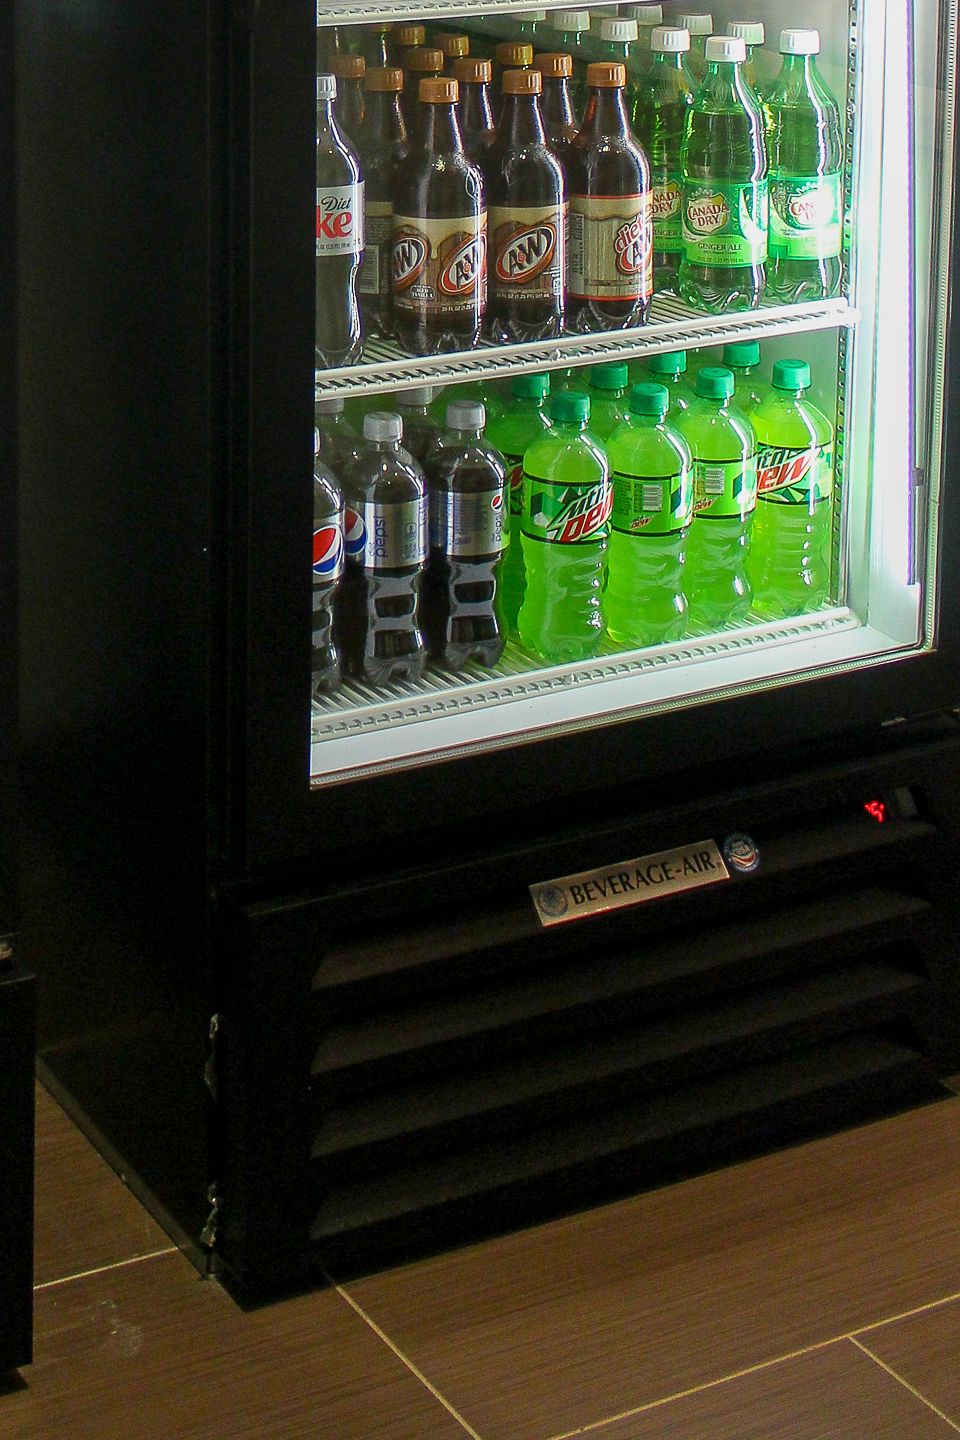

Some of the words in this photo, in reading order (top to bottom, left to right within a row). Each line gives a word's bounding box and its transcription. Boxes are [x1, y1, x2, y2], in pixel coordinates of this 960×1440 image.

[321, 195, 352, 211] Diet
[653, 191, 680, 205] NADA
[653, 201, 674, 214] DRY
[689, 203, 730, 221] CANADA
[316, 205, 352, 240] ke
[697, 215, 720, 227] DRY
[654, 229, 677, 237] INGER
[507, 229, 540, 277] A&W
[698, 243, 726, 251] GINGER
[757, 456, 811, 490] ew
[375, 515, 386, 558] pepsi
[569, 851, 716, 906] BEVERAGE-AIR
